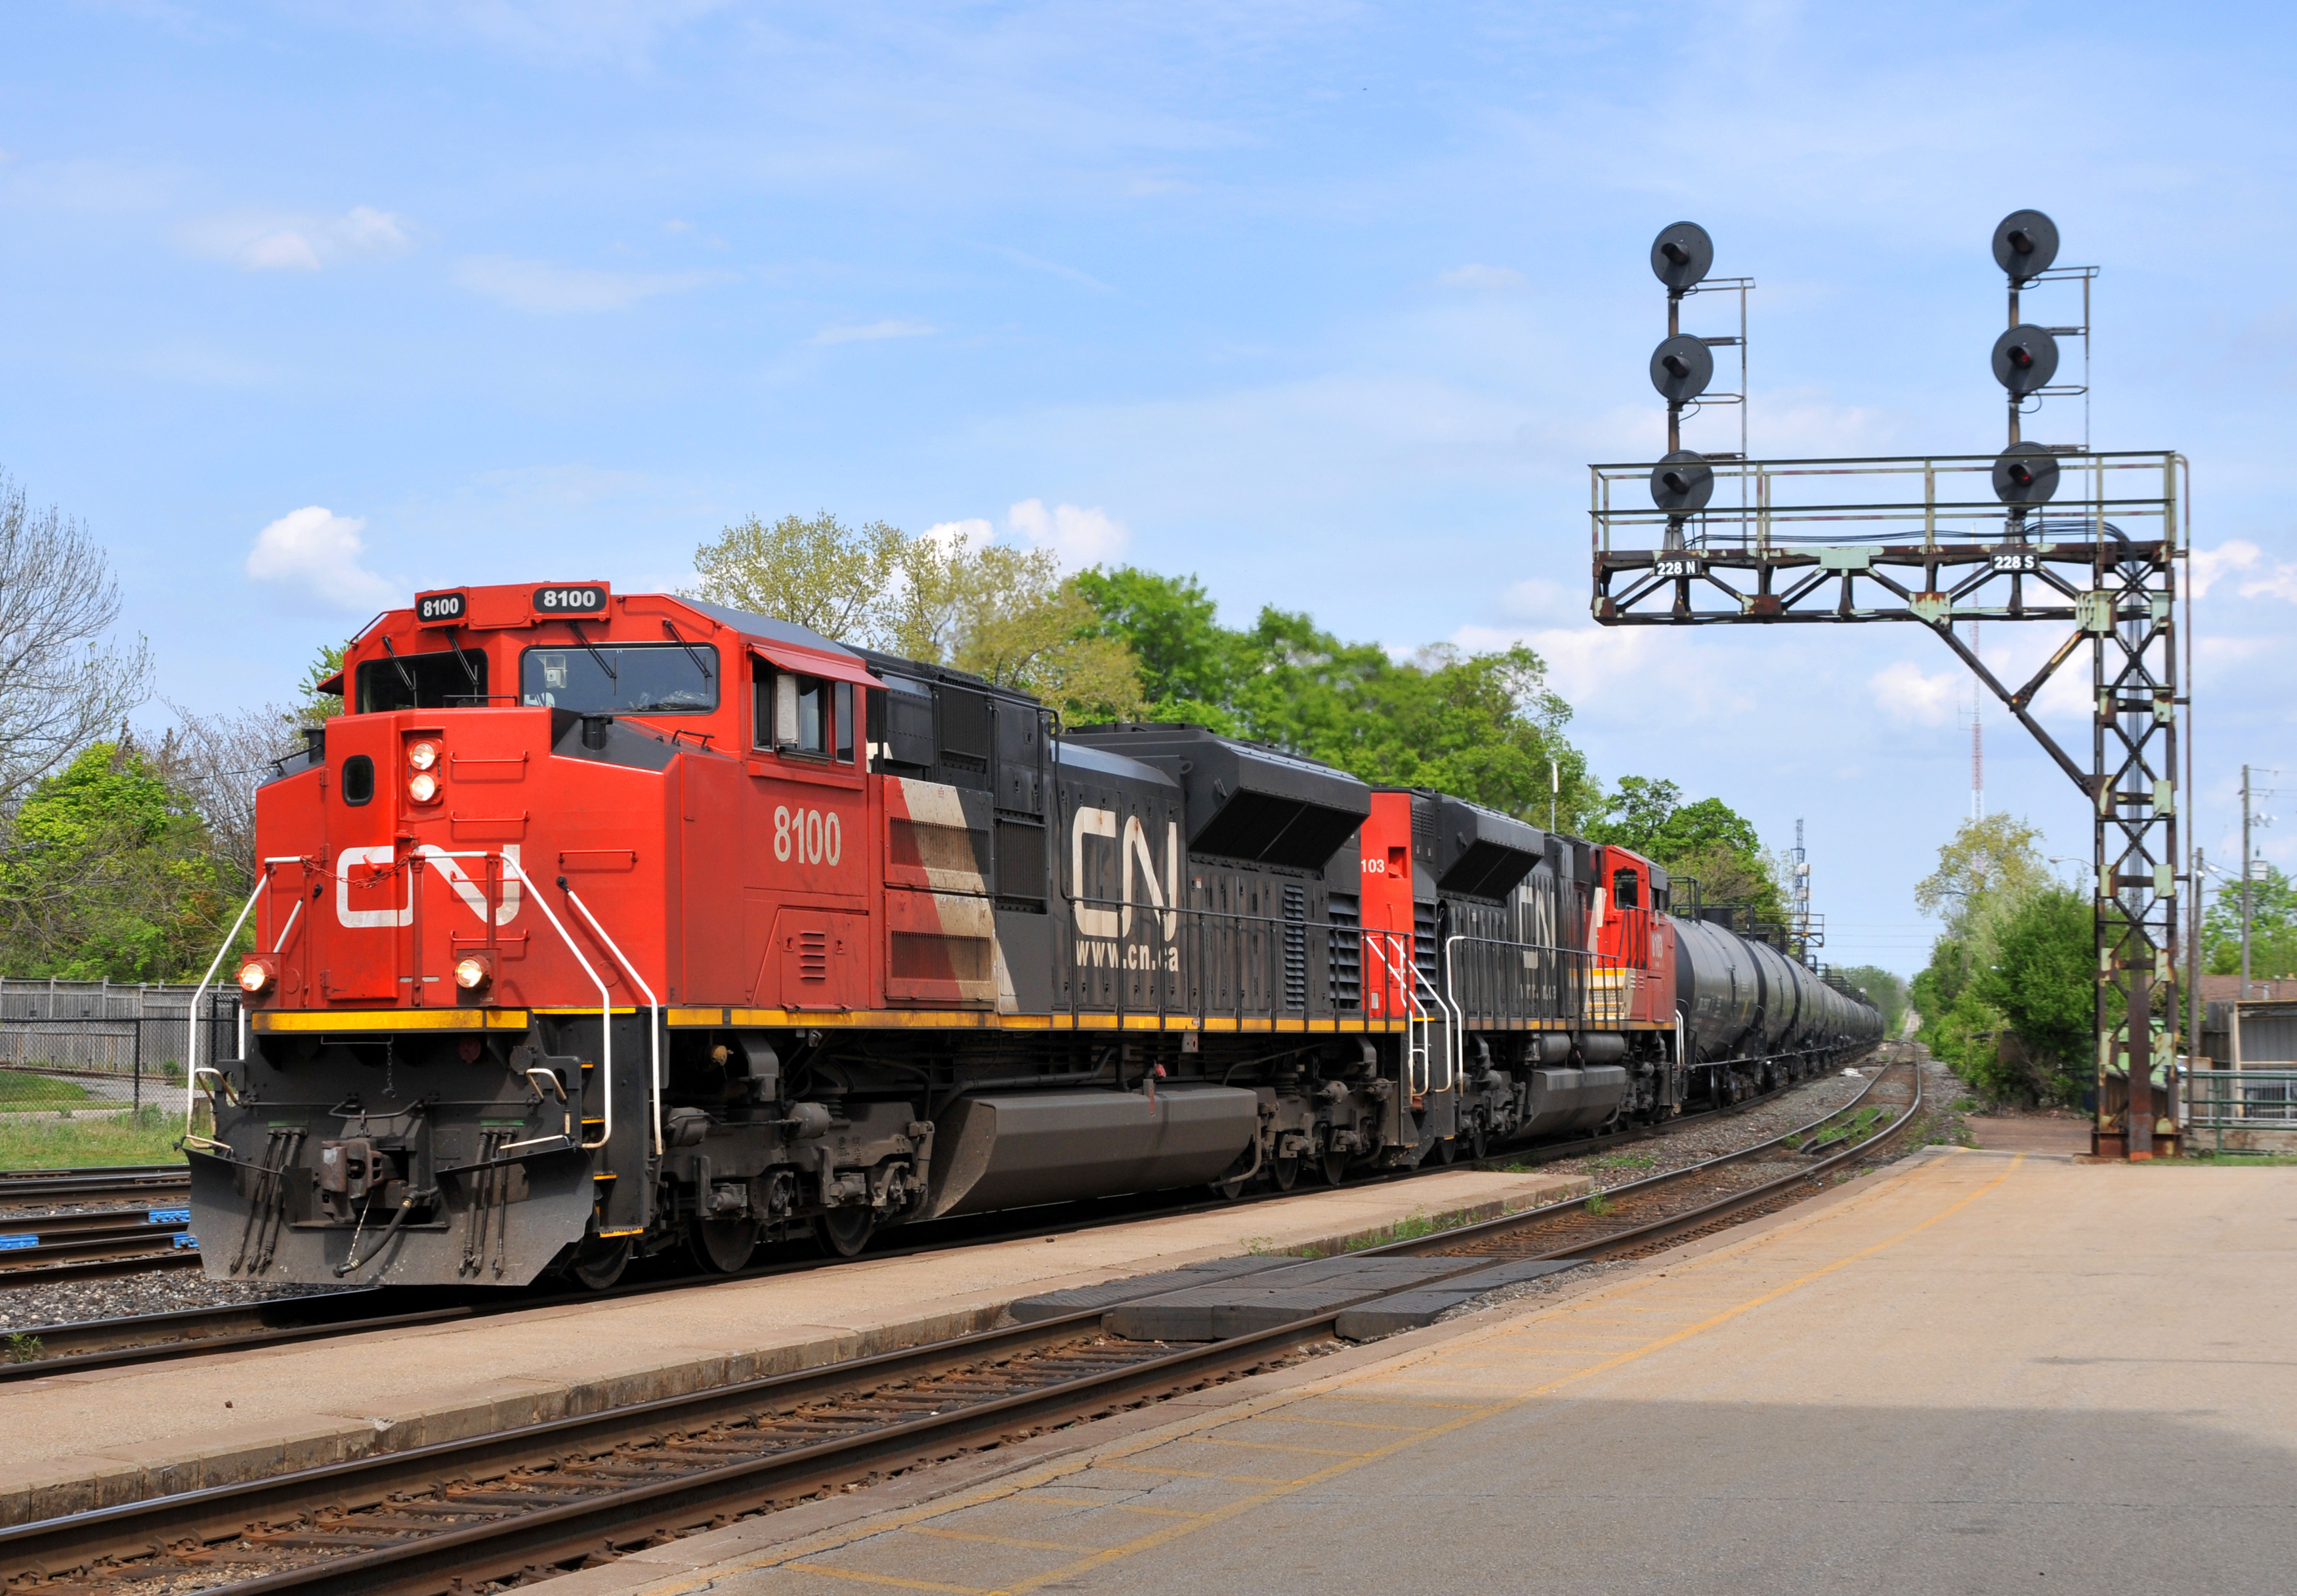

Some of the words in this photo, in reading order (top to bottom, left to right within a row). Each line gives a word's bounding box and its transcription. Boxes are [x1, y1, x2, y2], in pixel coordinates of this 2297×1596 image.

[1657, 562, 1683, 576] 228
[1686, 560, 1696, 574] N
[1994, 555, 2021, 569] 228
[2024, 555, 2034, 569] S
[423, 597, 459, 617] 8100
[543, 591, 596, 607] 8100
[774, 805, 841, 866] 8100
[1072, 806, 1177, 942] CN
[1360, 858, 1385, 873] 103
[336, 844, 520, 928] CN
[1519, 885, 1556, 970] CN
